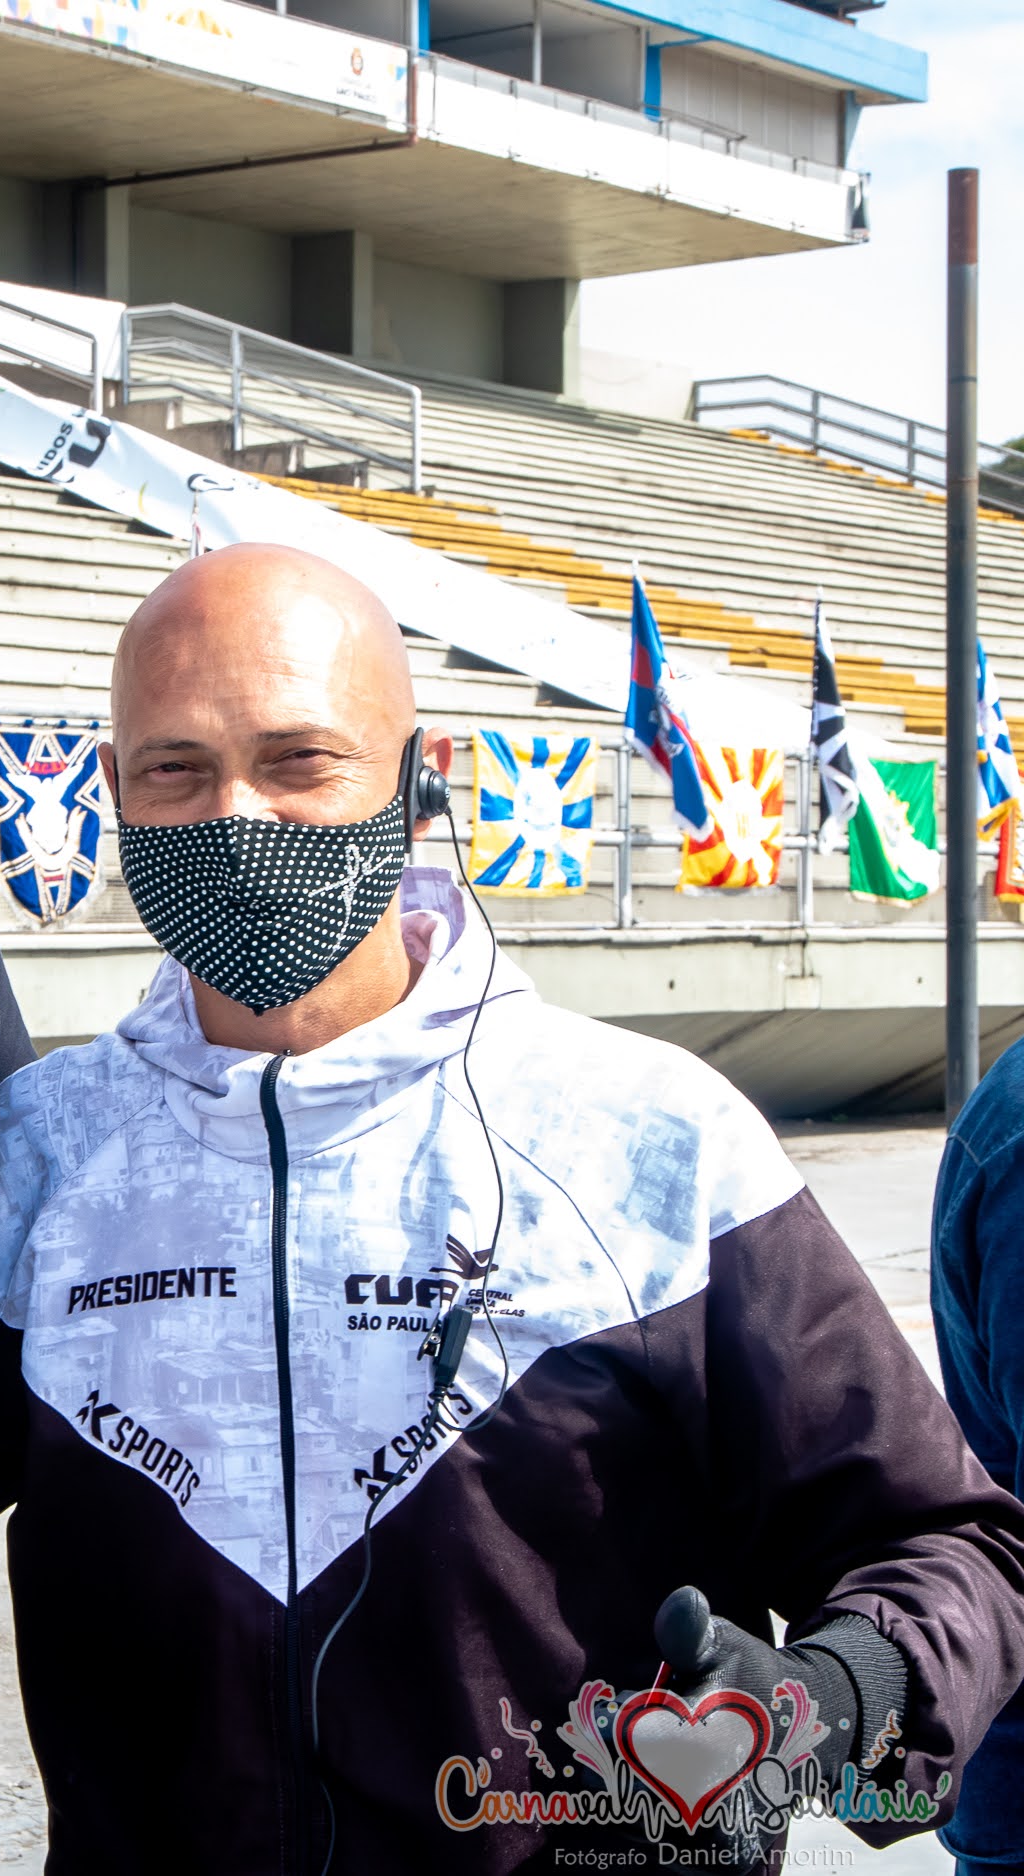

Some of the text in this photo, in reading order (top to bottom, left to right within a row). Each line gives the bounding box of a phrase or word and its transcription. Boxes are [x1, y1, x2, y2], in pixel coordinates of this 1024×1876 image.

[67, 1266, 238, 1315] PRESIDENTE
[347, 1312, 437, 1333] SÃO PAUL
[108, 1415, 201, 1508] SPORTS
